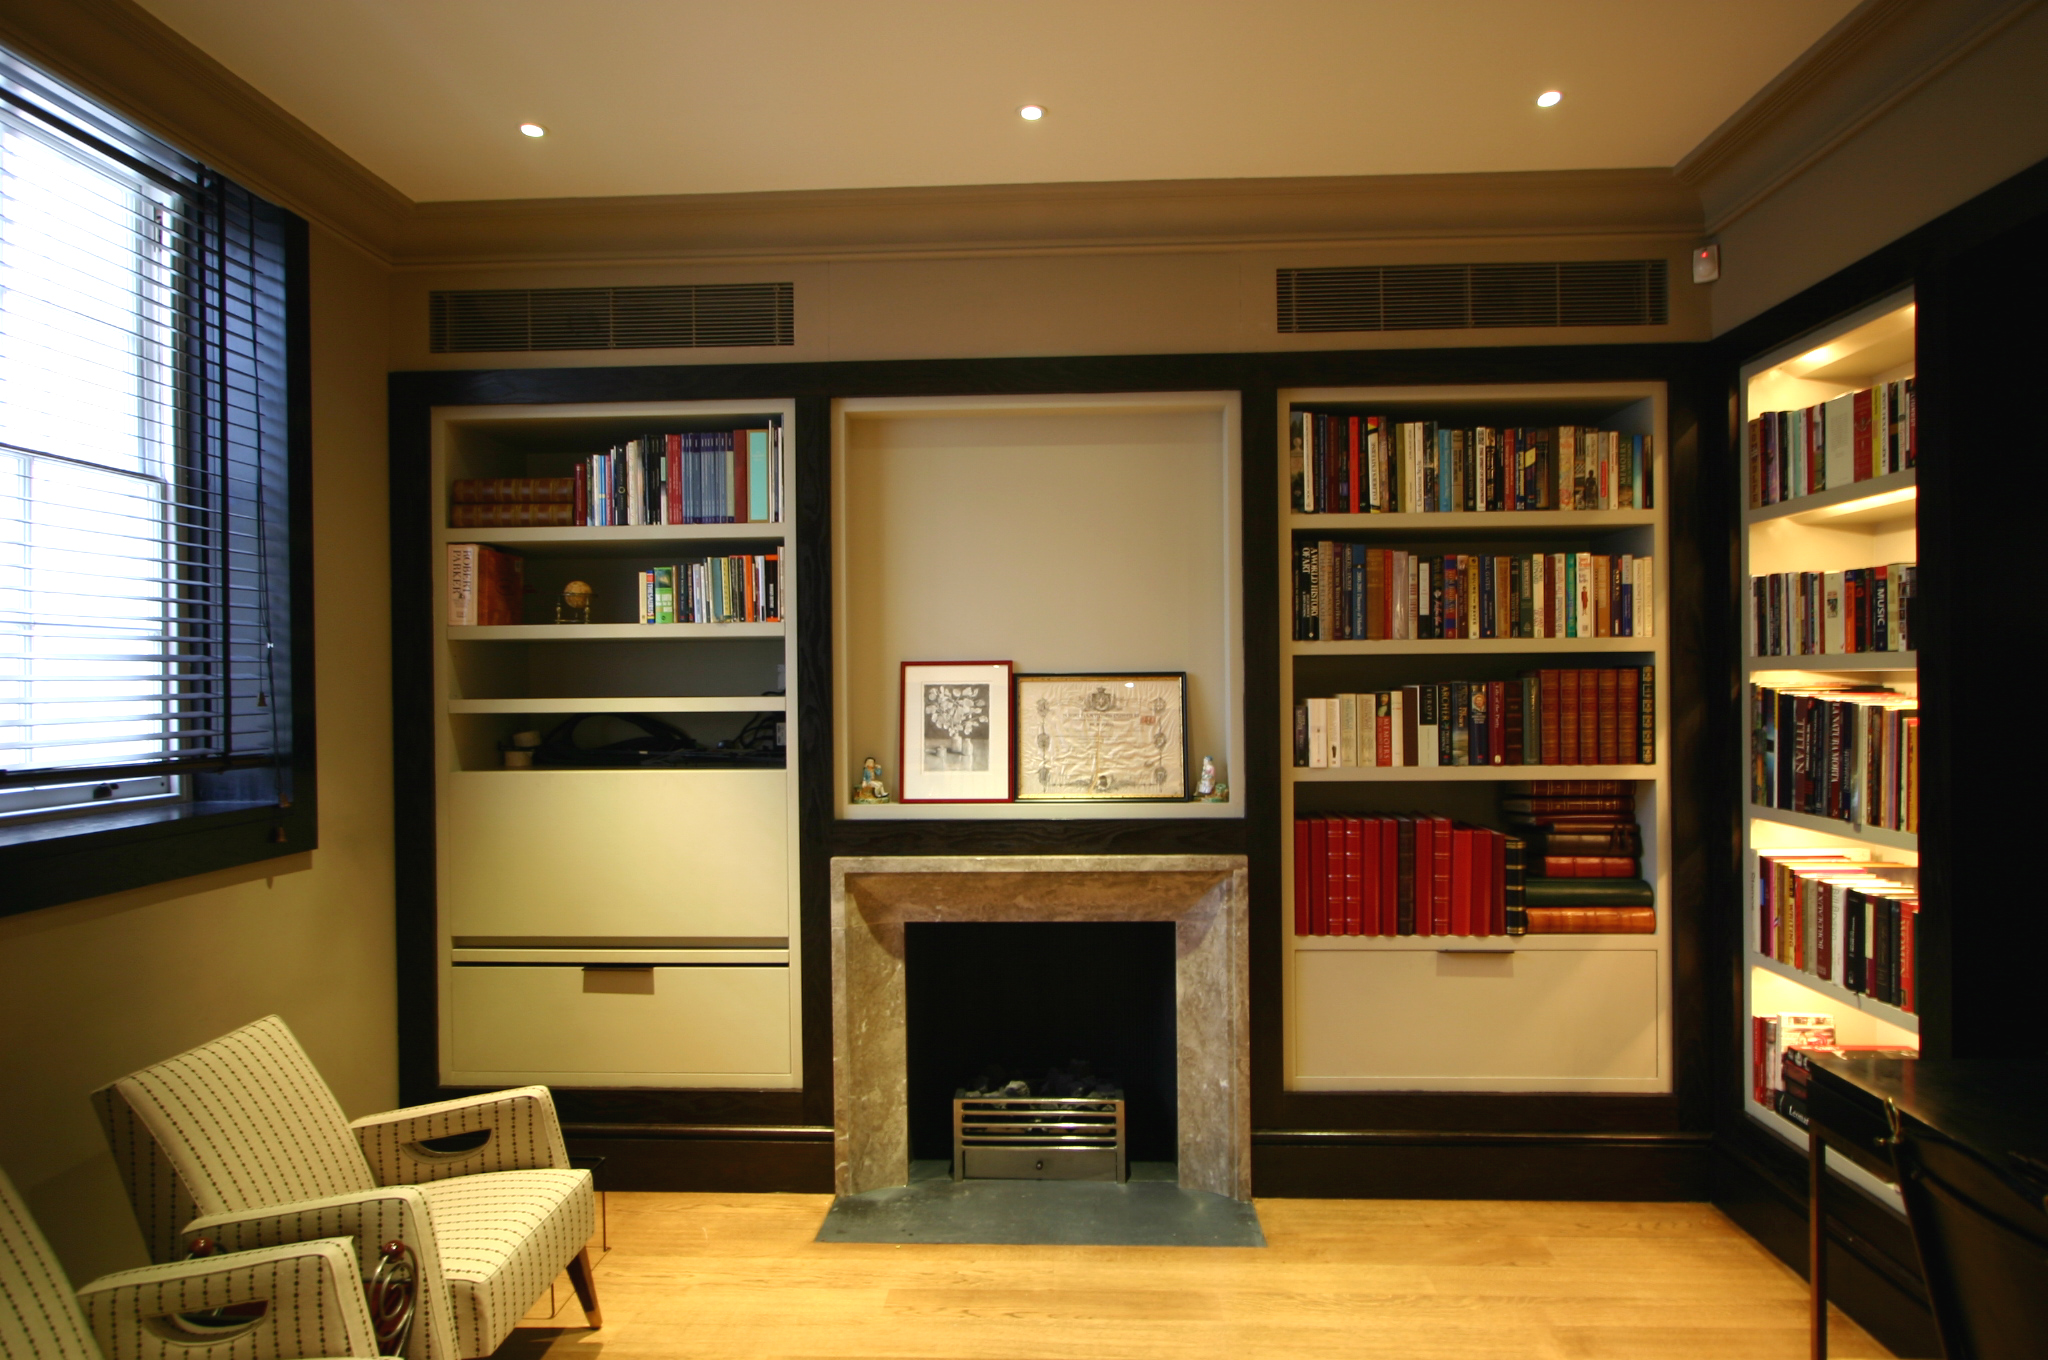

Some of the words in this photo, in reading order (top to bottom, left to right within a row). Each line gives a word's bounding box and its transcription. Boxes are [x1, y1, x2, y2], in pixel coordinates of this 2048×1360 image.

[1302, 547, 1311, 558] OF
[1302, 559, 1311, 574] ART
[1310, 554, 1318, 584] WORLD
[452, 550, 462, 595] PARKER
[463, 550, 472, 593] ROBERT
[1310, 585, 1318, 617] HISTORY
[1877, 588, 1886, 626] MUSIC
[1441, 686, 1450, 721] ARCHER
[1831, 702, 1841, 714] LA
[1795, 718, 1805, 774] TITAN
[1831, 714, 1841, 750] NATURA
[1830, 751, 1841, 782] MORTA
